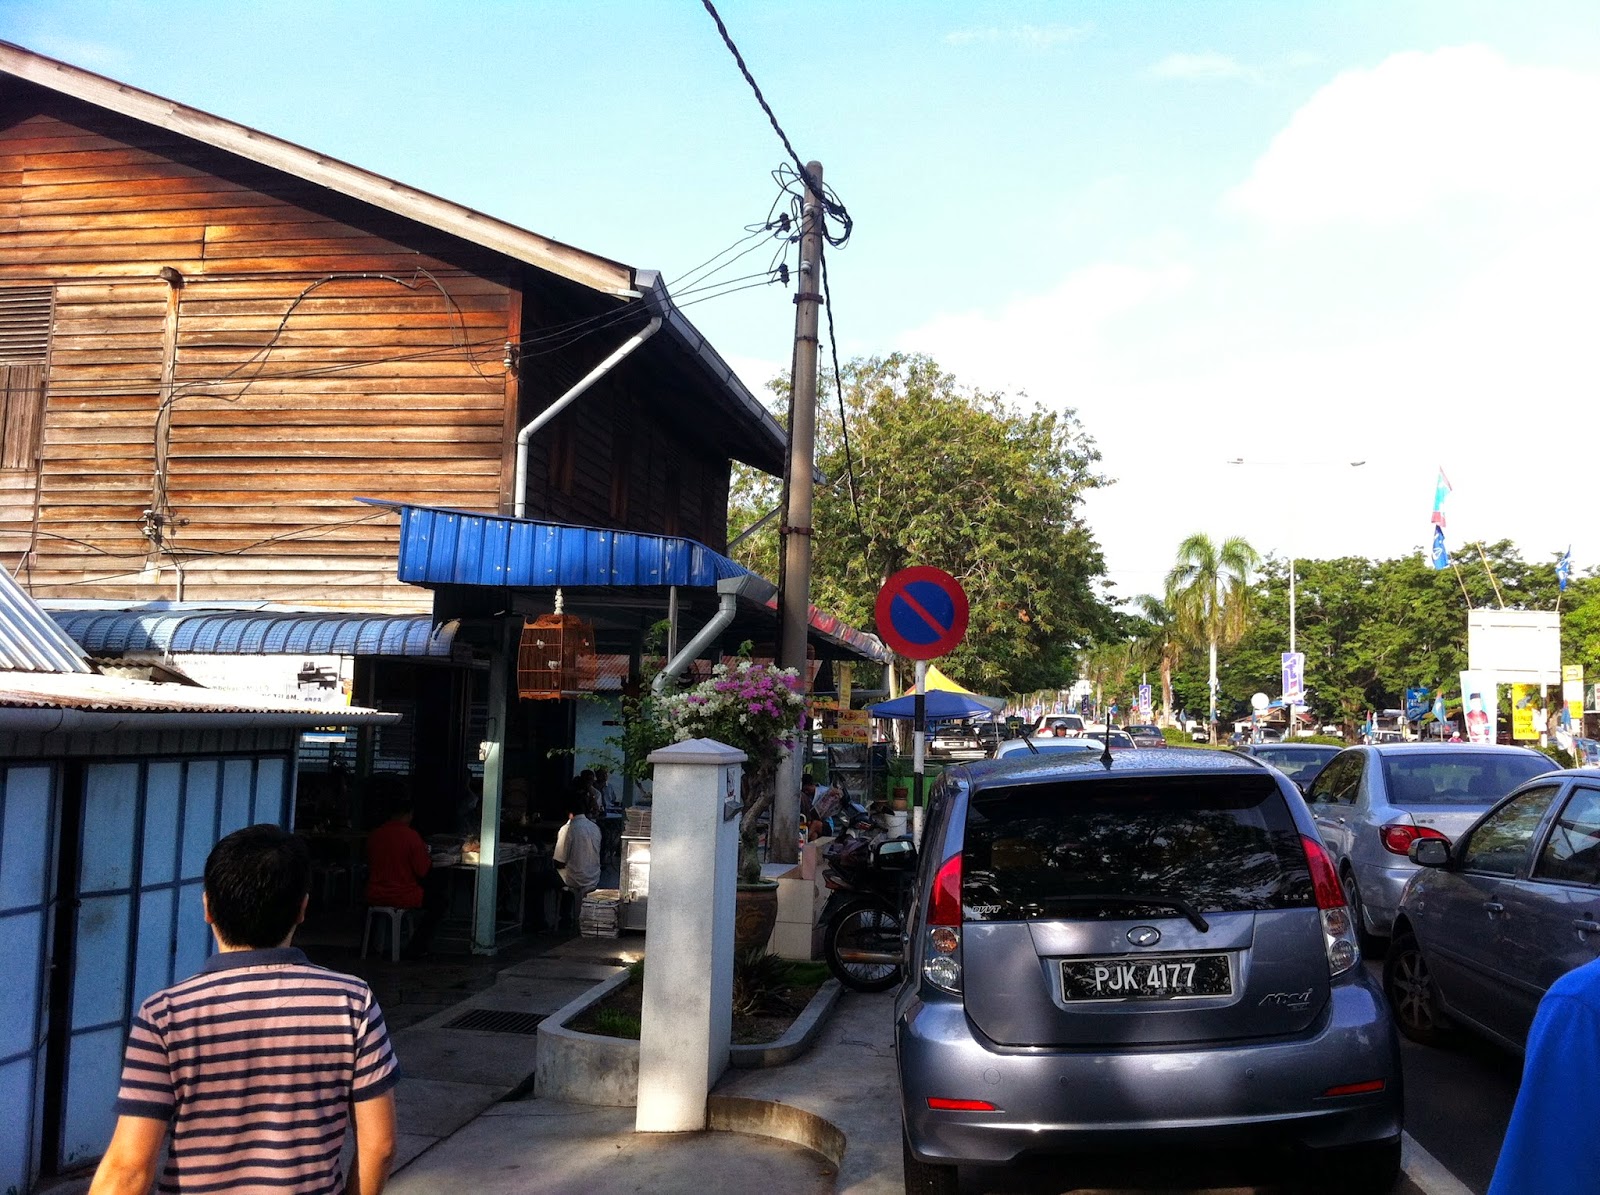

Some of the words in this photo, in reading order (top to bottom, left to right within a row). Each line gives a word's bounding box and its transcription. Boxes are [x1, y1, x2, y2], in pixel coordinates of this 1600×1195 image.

[969, 905, 1002, 914] DVVT
[1094, 965, 1139, 991] PJK
[1146, 963, 1196, 989] 4177
